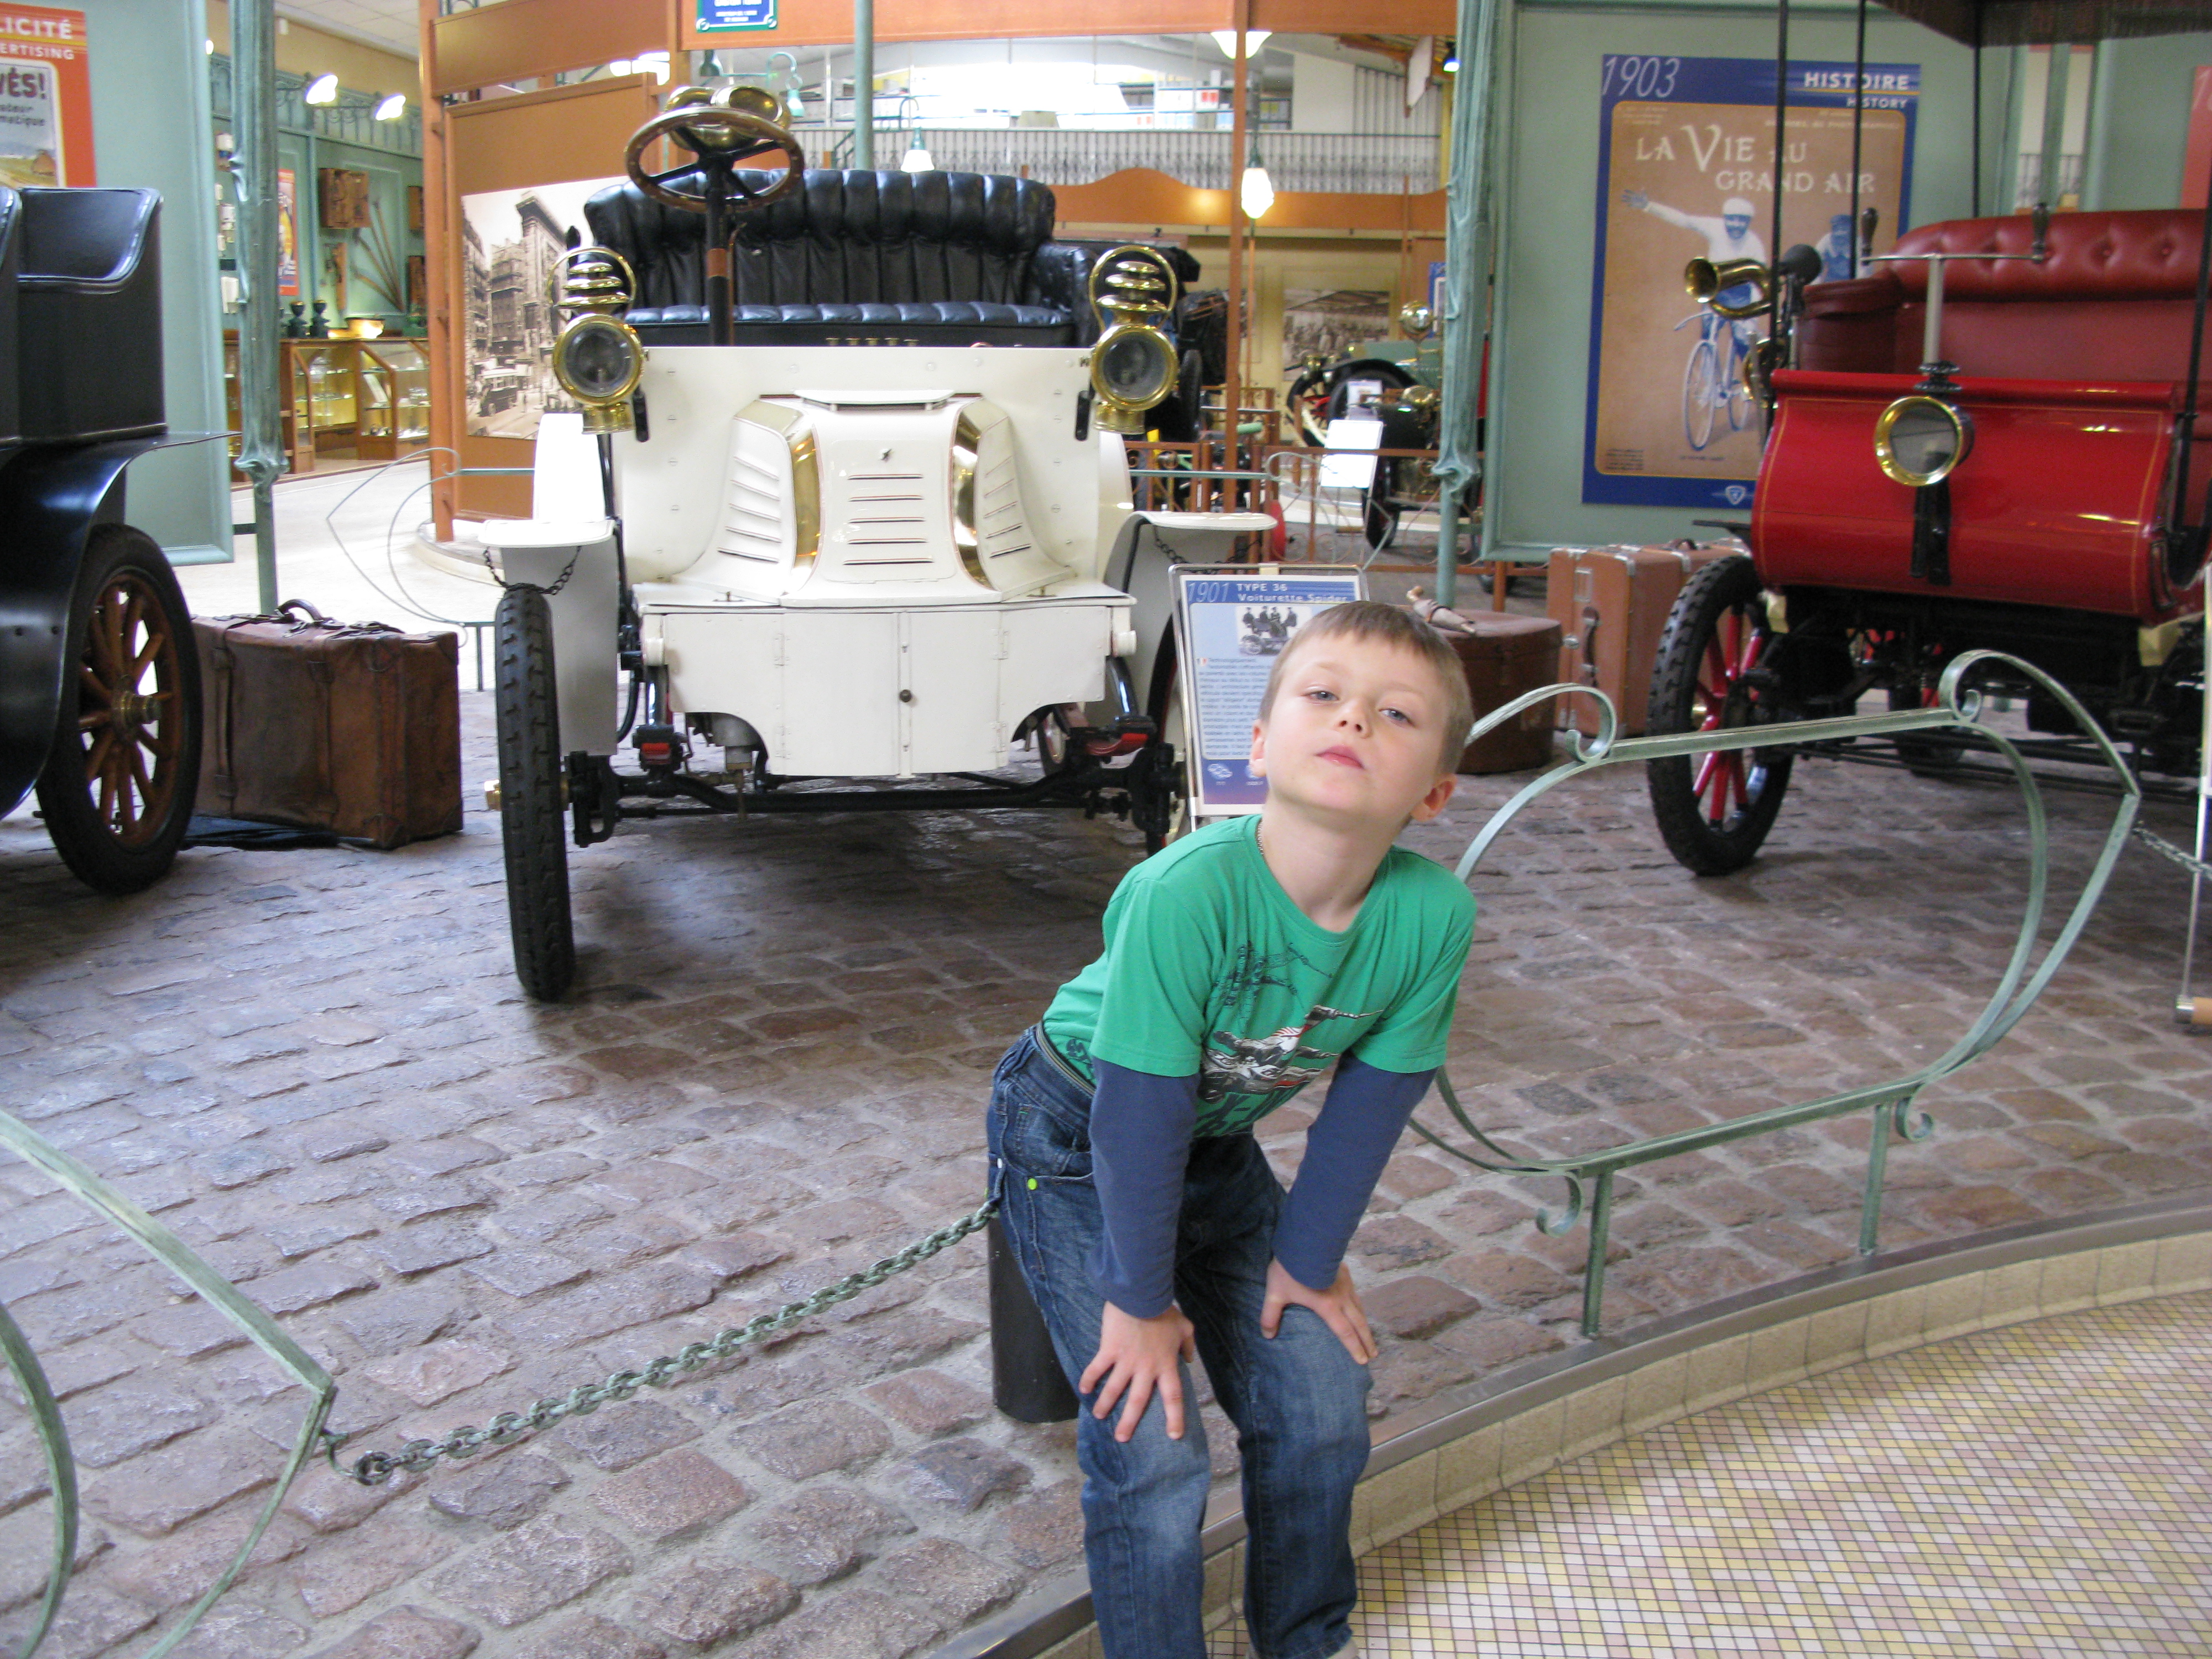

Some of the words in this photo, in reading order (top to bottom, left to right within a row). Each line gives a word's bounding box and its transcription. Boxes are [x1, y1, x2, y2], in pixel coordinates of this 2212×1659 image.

[0, 17, 73, 40] ICITÉ
[1603, 56, 1680, 97] 1903
[1846, 97, 1907, 109] HSTORY
[1636, 137, 1675, 161] LA
[1680, 124, 1755, 173] VIE
[1825, 171, 1876, 194] AIR
[1189, 582, 1229, 602] 1901
[1237, 583, 1267, 592] TYPE
